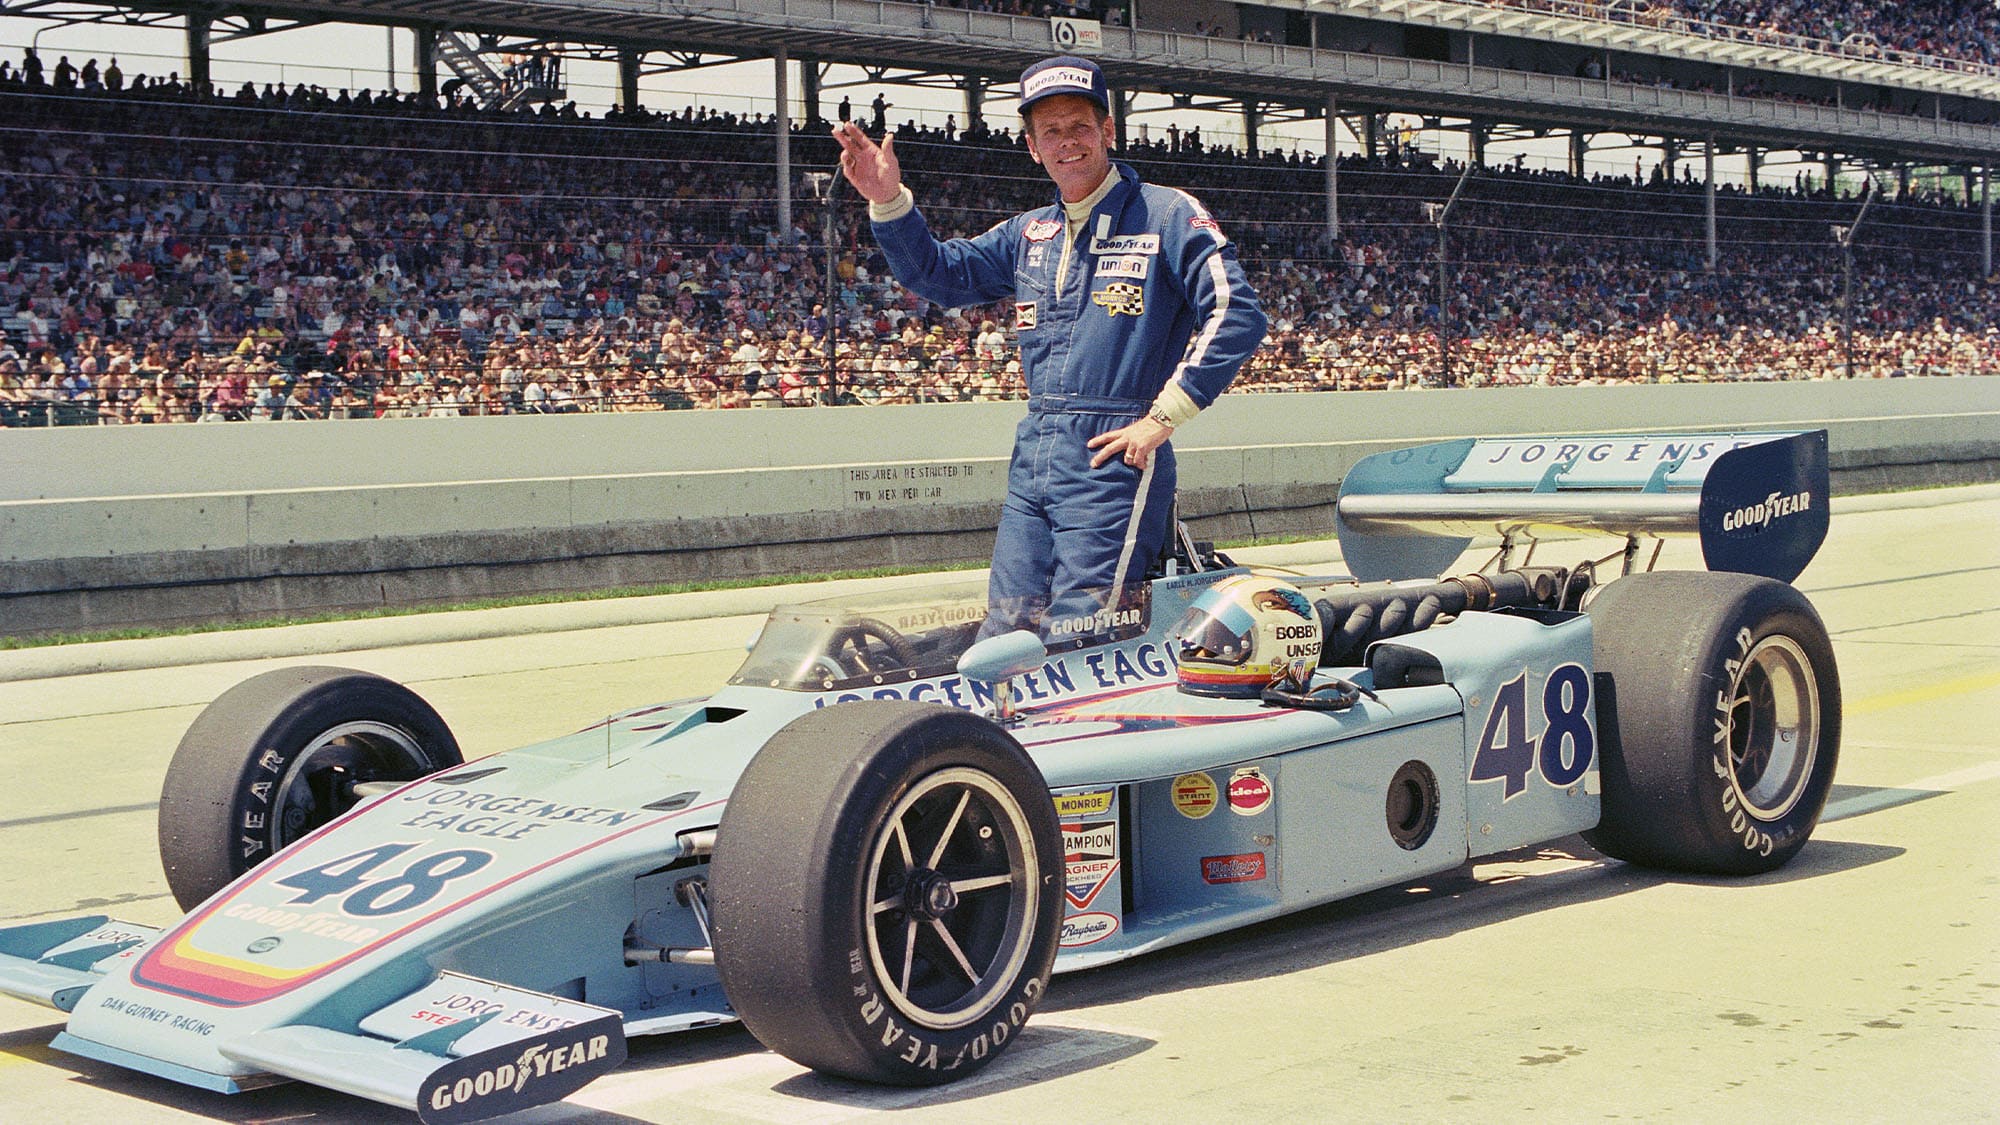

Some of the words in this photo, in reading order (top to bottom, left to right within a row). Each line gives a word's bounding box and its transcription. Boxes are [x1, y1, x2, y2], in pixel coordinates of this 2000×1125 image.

[850, 470, 870, 481] THIS
[872, 469, 898, 480] AREA
[904, 466, 958, 479] RESTRICTED
[964, 465, 973, 476] TO
[854, 490, 871, 502] TWO
[878, 489, 897, 500] MEN
[903, 487, 919, 499] PER
[925, 487, 942, 498] CAR
[1723, 491, 1811, 531] GOODYEAR
[1051, 609, 1141, 636] GOODYEAR
[1276, 624, 1317, 640] BOBBY
[1086, 640, 1195, 688] EAGL
[1286, 642, 1322, 658] UNSER
[1469, 661, 1595, 802] 48
[1713, 626, 1774, 857] GOODYEAR
[1061, 798, 1103, 811] MONROE
[1230, 785, 1268, 797] ideal
[403, 788, 641, 826] JORGENSEN
[401, 810, 549, 839] EAGLE
[1065, 834, 1112, 849] AMPION
[270, 839, 498, 919] 48
[1065, 863, 1109, 875] AGNER
[1066, 873, 1102, 882] CKHEED
[224, 903, 379, 944] GOODYEAR
[101, 998, 124, 1011] DAN
[125, 1003, 171, 1024] GURNEY
[170, 1015, 215, 1036] RACING
[861, 977, 1041, 1070] GOODYEAR
[431, 1034, 609, 1111] GOODYEAR
